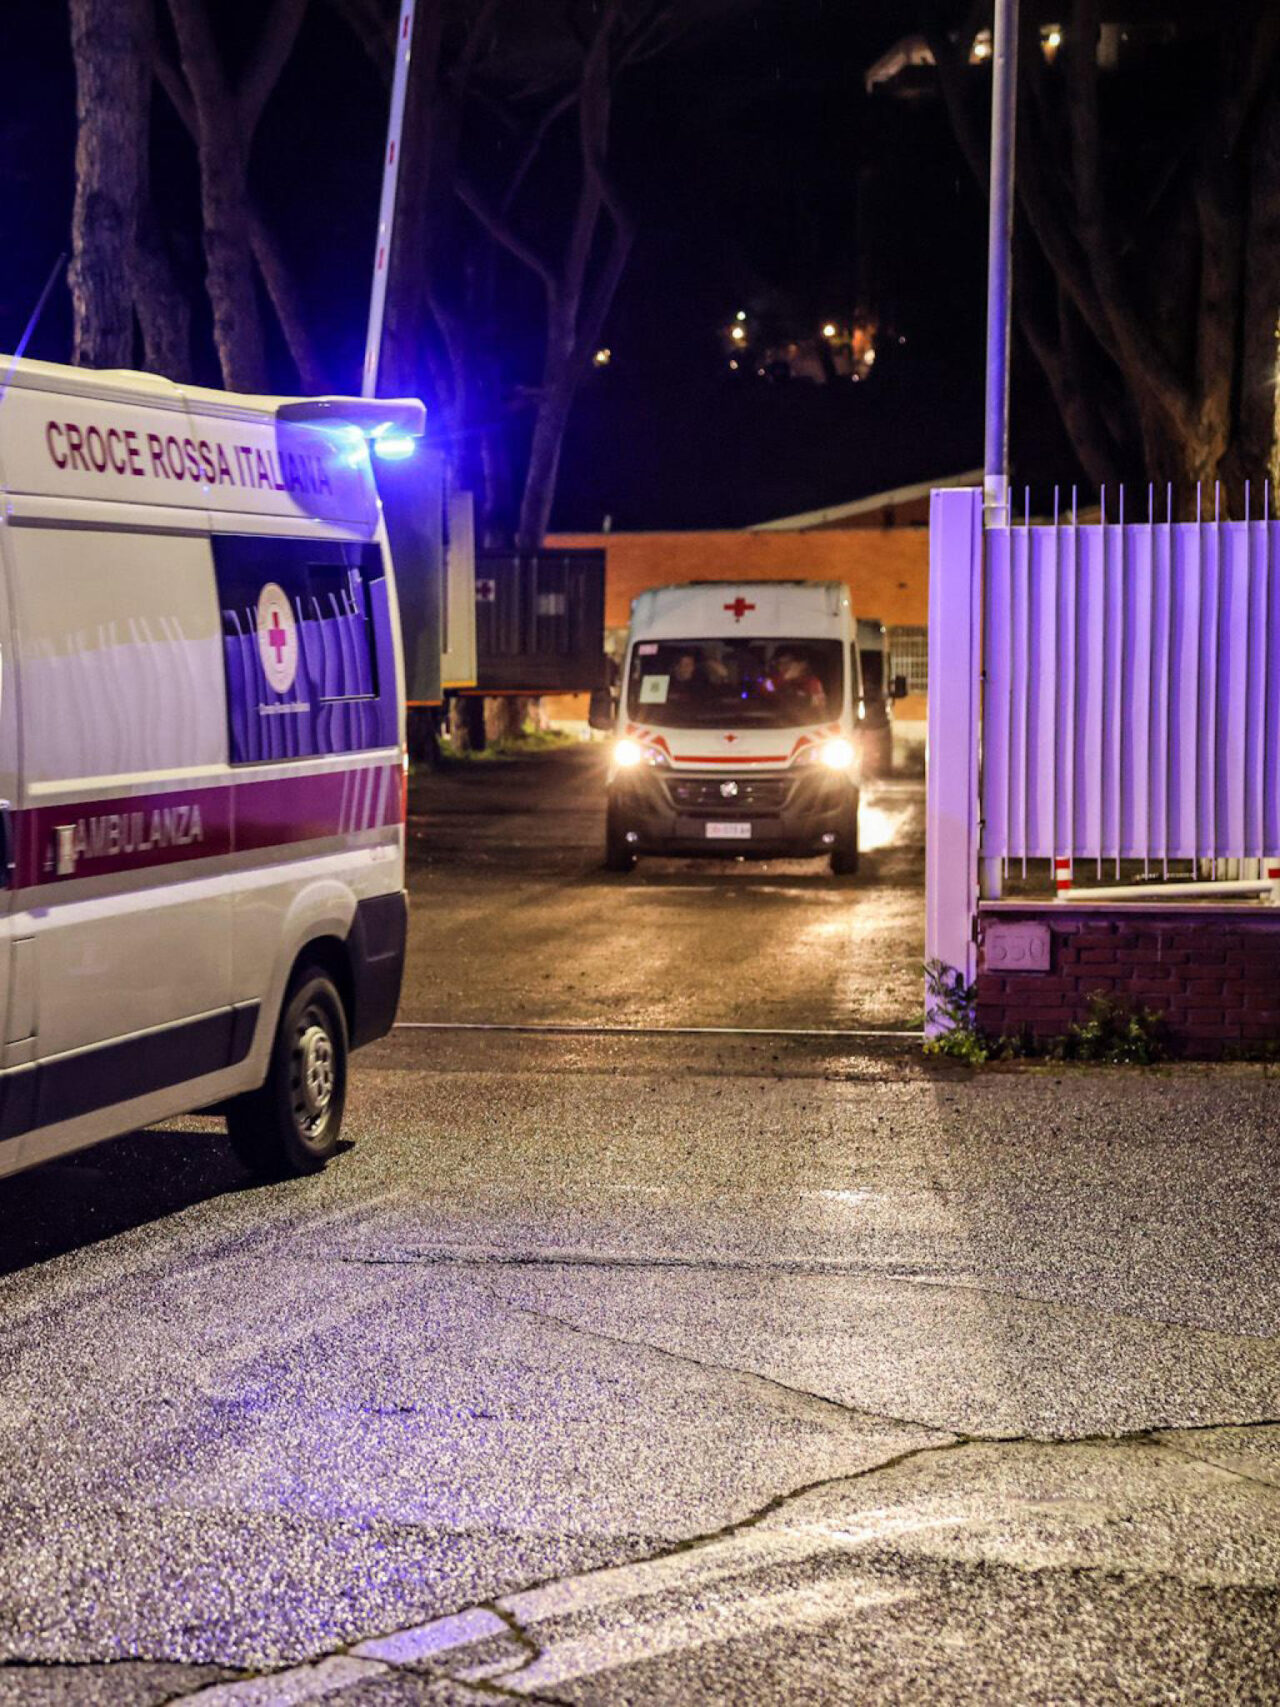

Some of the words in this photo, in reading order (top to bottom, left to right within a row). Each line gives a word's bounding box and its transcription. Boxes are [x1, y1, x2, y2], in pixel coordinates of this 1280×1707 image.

[46, 420, 144, 477] CROCE
[147, 434, 235, 487] ROSSA
[234, 445, 333, 495] ITALIANA
[74, 804, 204, 860] AMBULANZA
